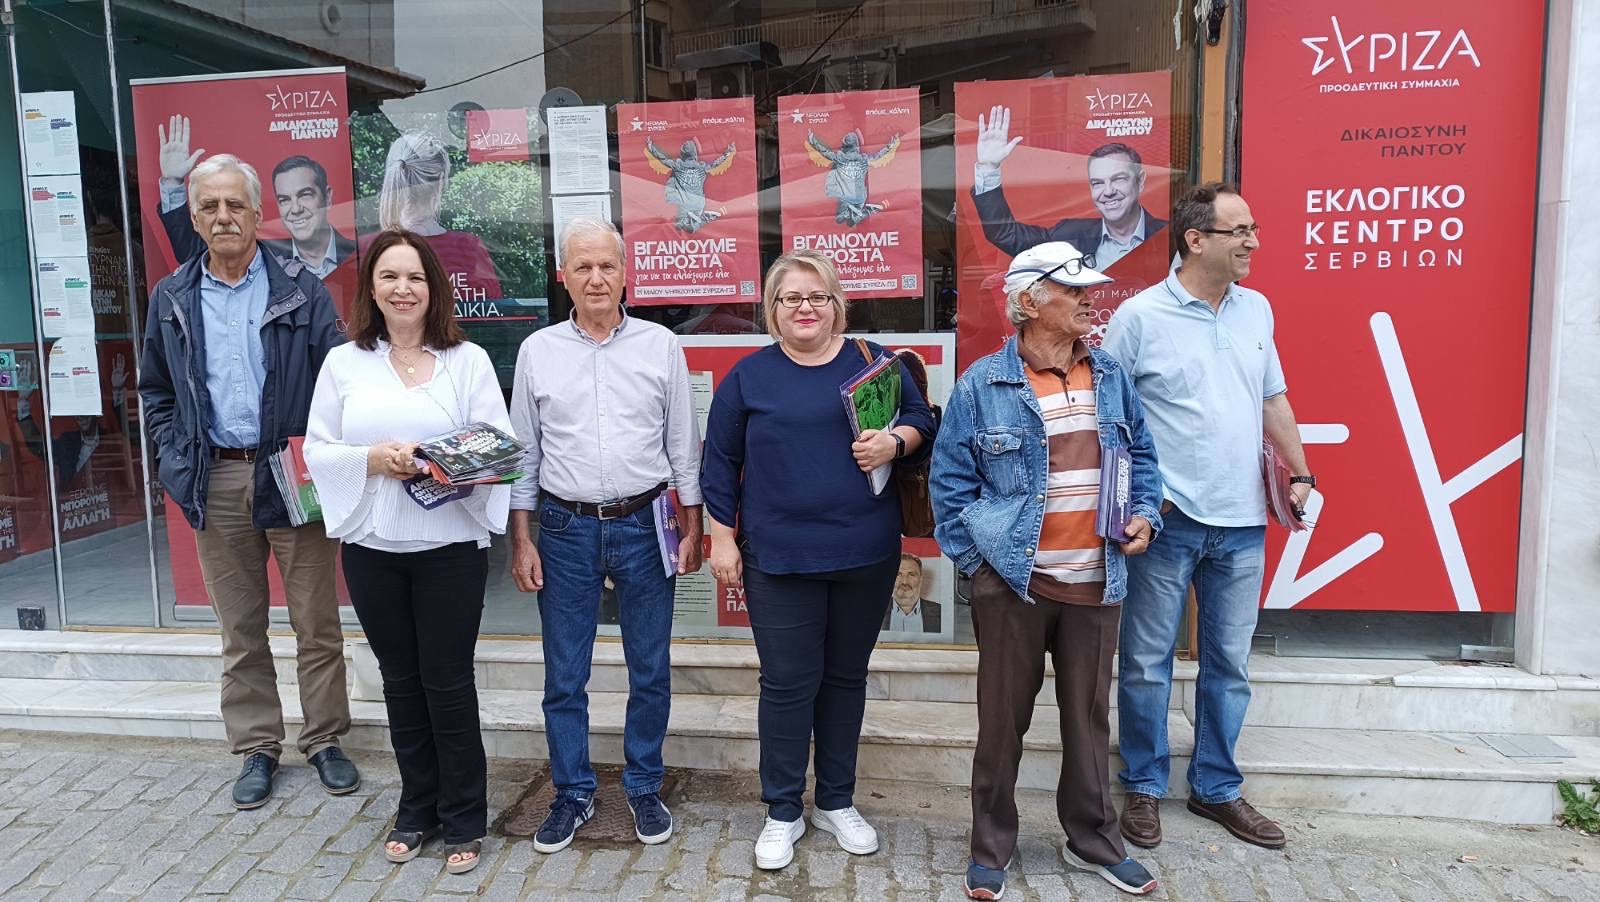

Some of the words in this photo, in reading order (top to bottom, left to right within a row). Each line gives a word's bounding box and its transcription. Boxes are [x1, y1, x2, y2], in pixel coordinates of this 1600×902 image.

[1301, 15, 1481, 76] ΣΥΡΙΖΑ
[1319, 80, 1398, 93] ΠΡΟΟΔΕΥΤΙΚΗ
[1401, 78, 1460, 90] ΣΥΜΜΑΧΙΑ
[265, 84, 337, 111] ΣΥΡΙΖΑ
[1085, 87, 1153, 111] ΣΥΡΙΖΑ
[269, 117, 338, 132] ΔΙΚΑΙΟΣΥΝΗ
[1085, 117, 1153, 129] ΔΙΚΑΙΟΣΥΝΗ
[1106, 126, 1152, 137] ΠΑΝΤΟΥ
[291, 127, 338, 140] ΠΑΝΤΟΥ
[473, 129, 522, 146] ΣΥΡΙΖΑ
[1340, 124, 1467, 142] ΔΙΚΑΙΟΣΥΝΗ
[1380, 142, 1467, 158] ΠΑΝΤΟΥ
[1306, 184, 1466, 213] ΕΚΛΟΓΙΚΟ
[1304, 216, 1465, 245] ΚΕΝΤΡΟ
[634, 238, 737, 256] ΒΓΑΙΝΟΥΜΕ
[793, 231, 899, 250] ΒΓΑΙΝΟΥΜΕ
[90, 254, 127, 265] ΓΥΡΝΑΜ
[635, 254, 723, 270] ΜΠΡΟΣΤΑ
[794, 247, 884, 264] ΡΟΣΤΑ
[1304, 248, 1464, 271] ΣΕΡΒΙΩΝ
[1094, 290, 1105, 299] 21
[61, 493, 108, 512] ΜΠΟΡΟΥΜΕ
[63, 508, 110, 532] ΑΛΛΑΓΗ
